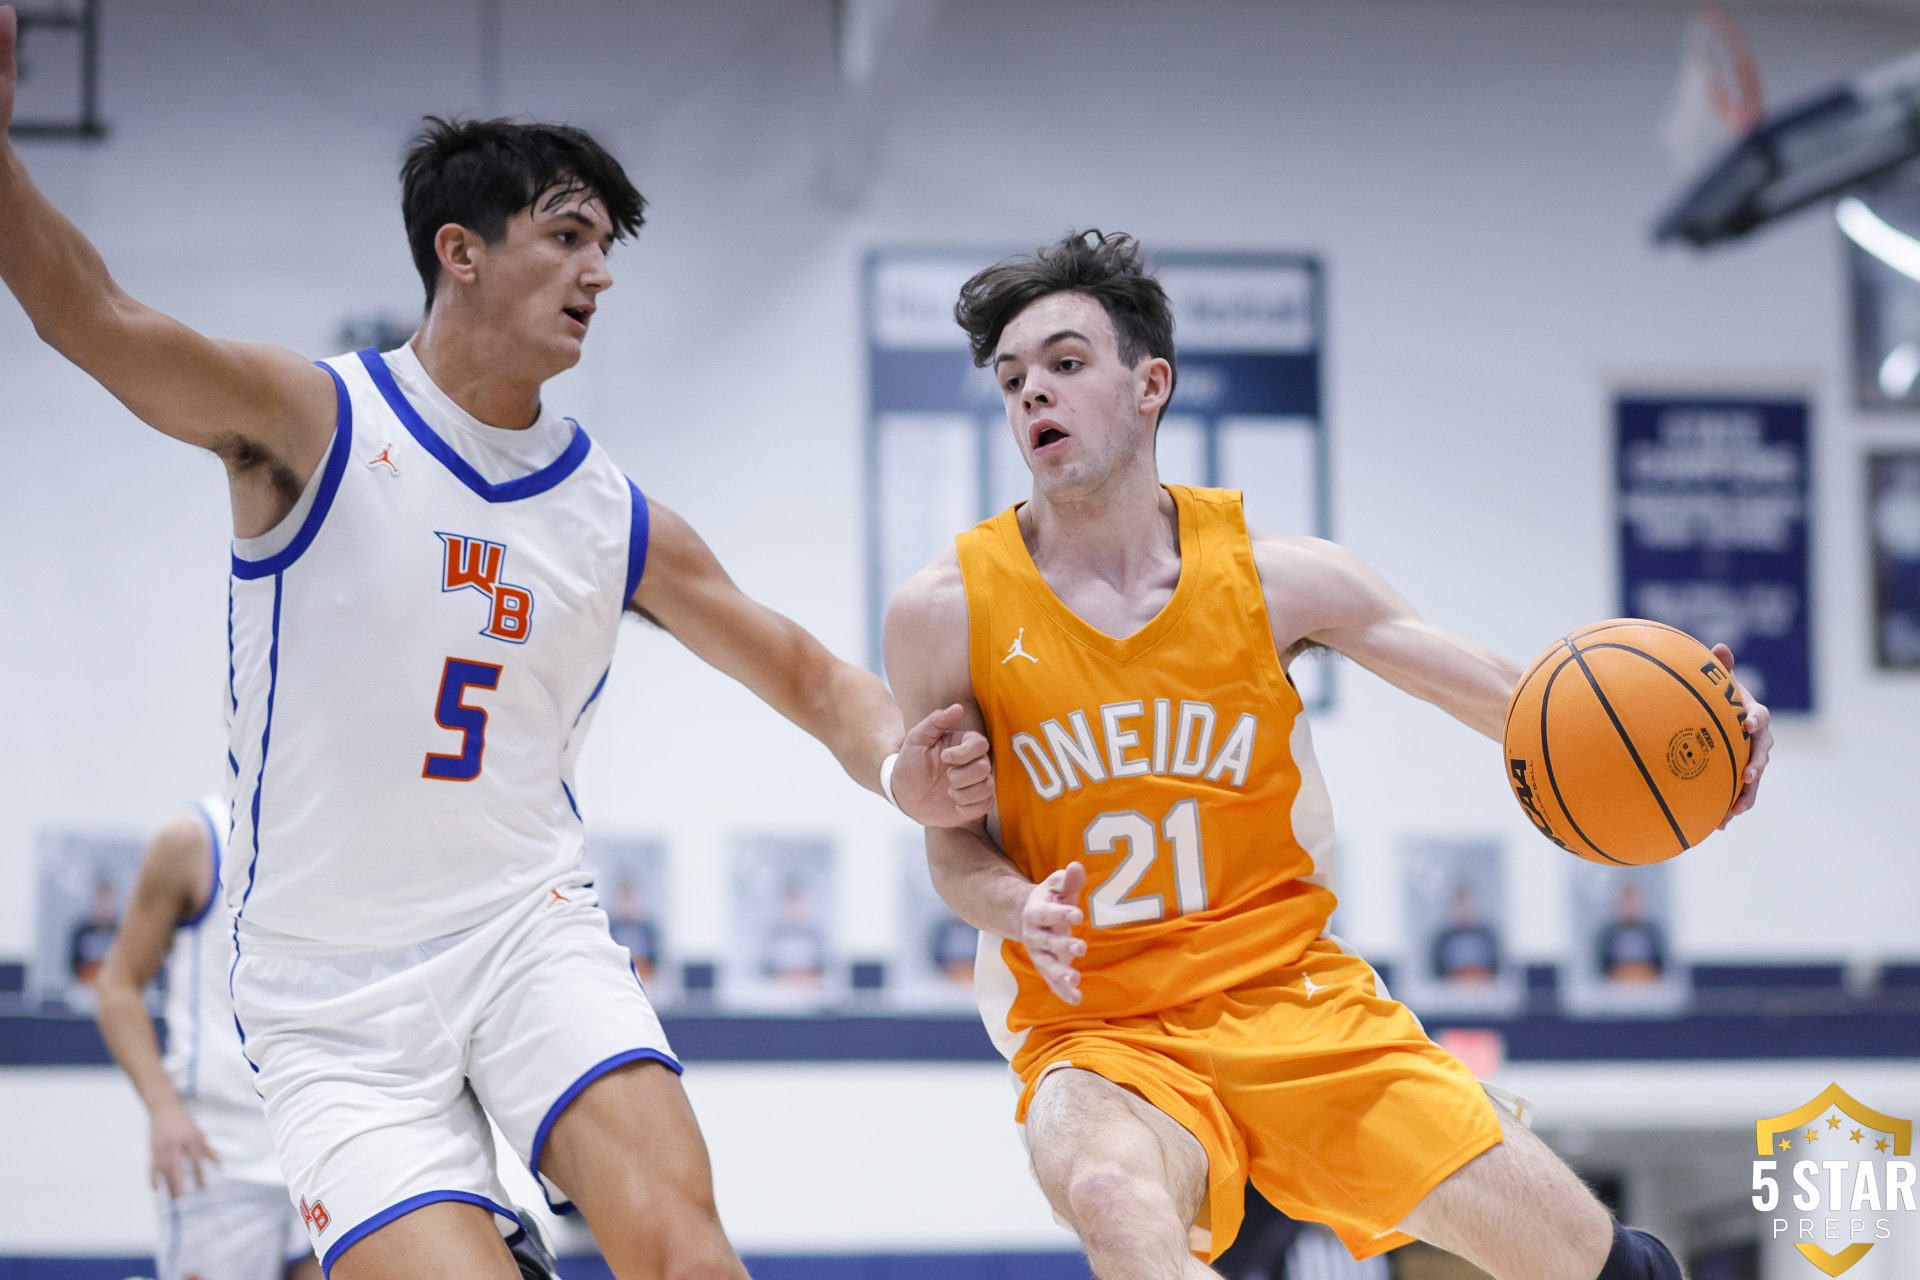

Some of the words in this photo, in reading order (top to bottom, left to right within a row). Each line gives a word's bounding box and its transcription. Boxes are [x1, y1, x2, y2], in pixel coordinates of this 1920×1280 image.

[434, 530, 535, 645] WB
[422, 656, 503, 781] 5
[1012, 699, 1258, 801] ONEIDA
[1083, 798, 1208, 929] 21
